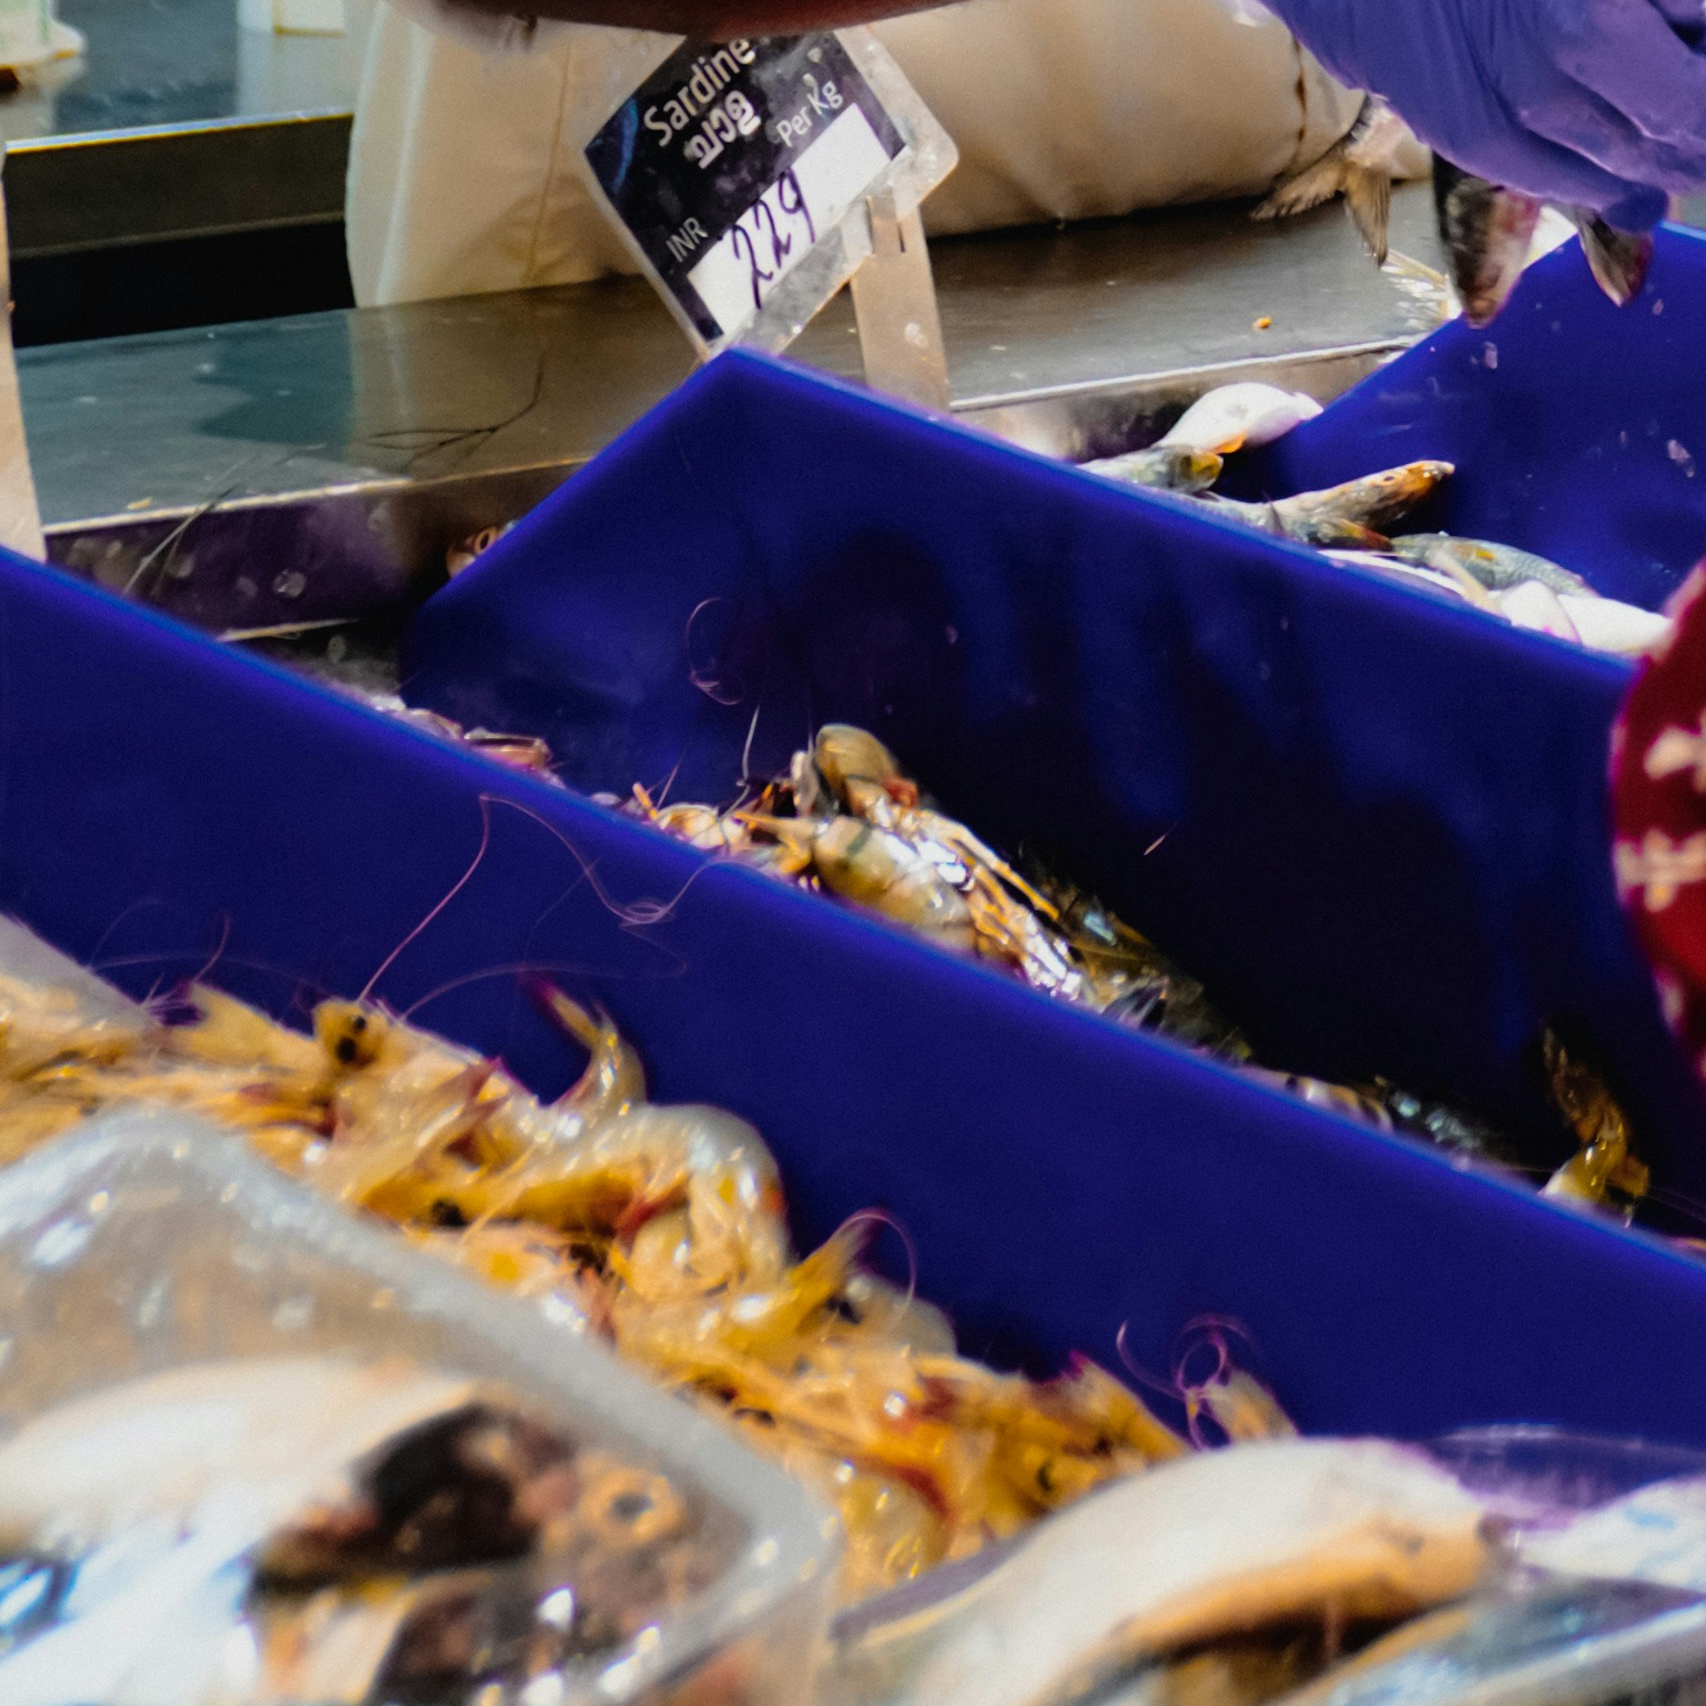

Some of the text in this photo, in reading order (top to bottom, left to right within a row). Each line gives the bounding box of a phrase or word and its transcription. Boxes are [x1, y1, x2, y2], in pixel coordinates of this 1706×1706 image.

[643, 39, 757, 148] Sardine
[776, 80, 844, 147] Per Kg
[665, 217, 708, 263] INR
[727, 164, 816, 310] 229
